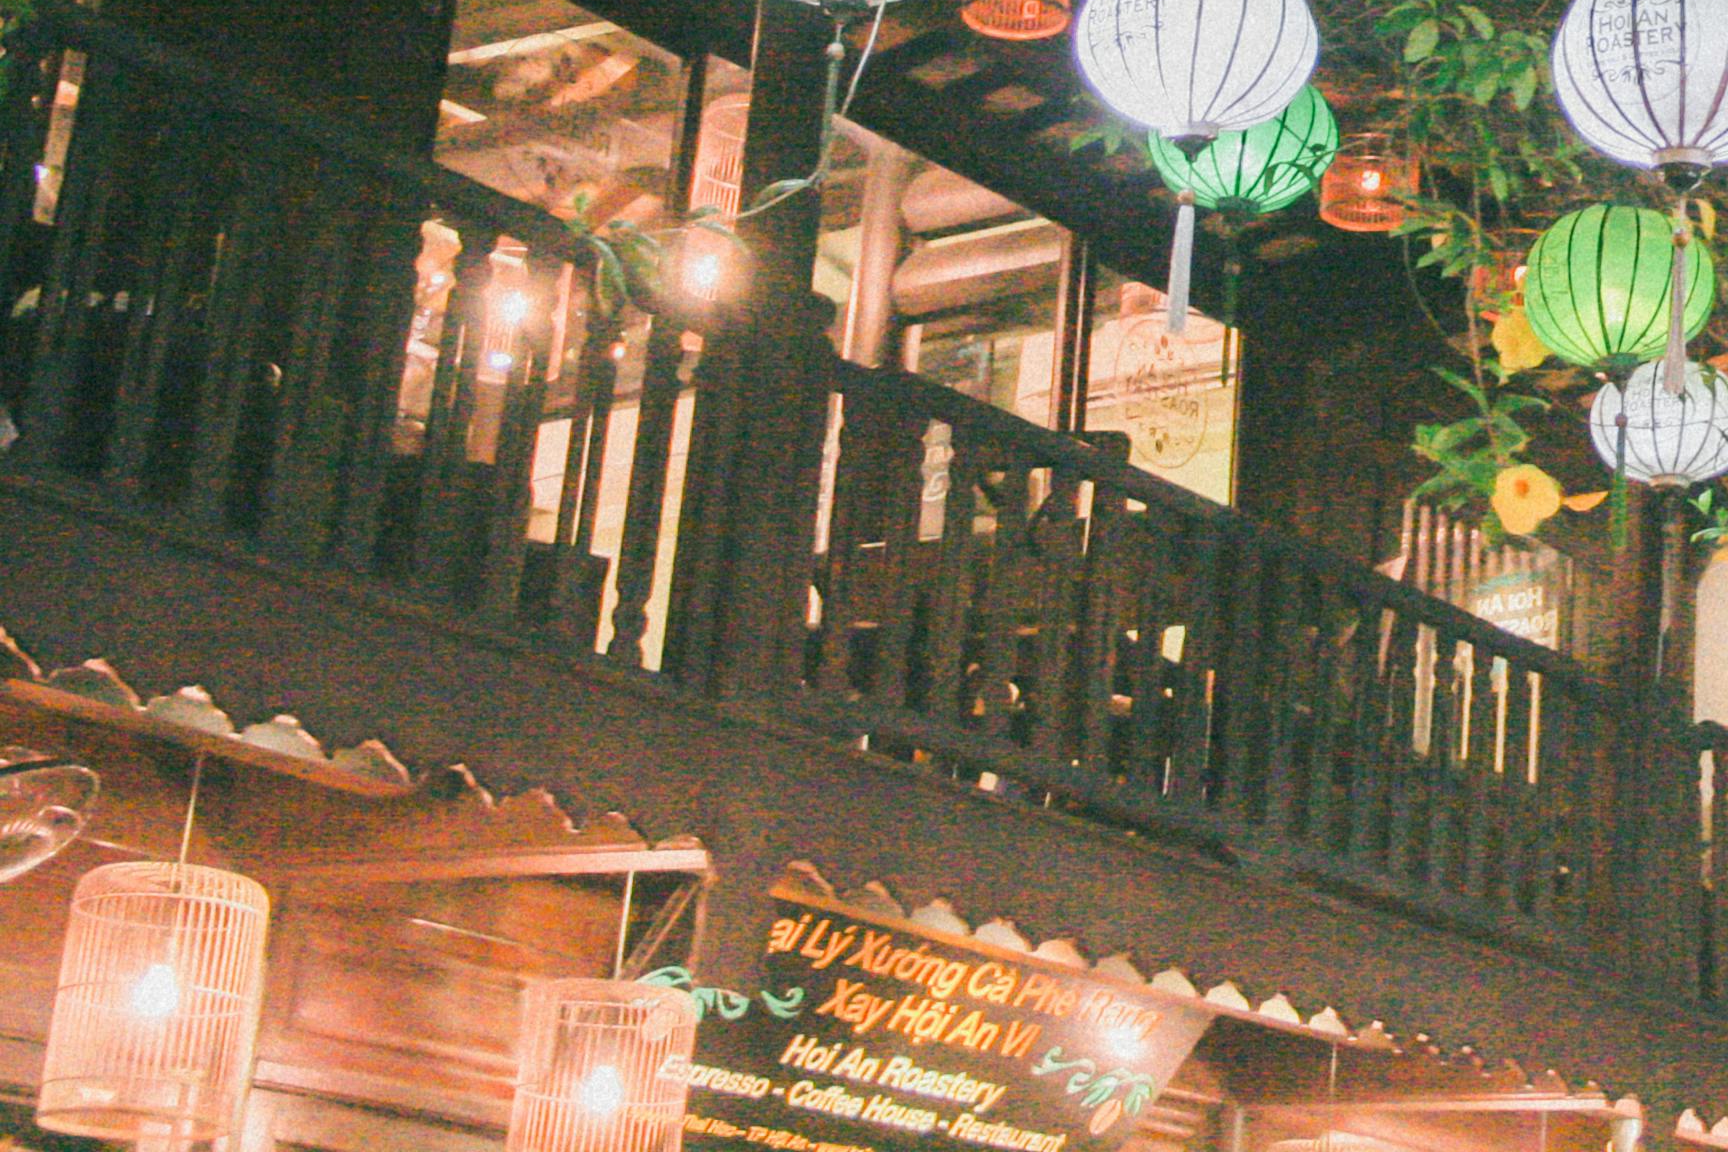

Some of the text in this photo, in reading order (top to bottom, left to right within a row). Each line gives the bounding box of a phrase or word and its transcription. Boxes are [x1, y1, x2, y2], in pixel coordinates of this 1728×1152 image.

[1635, 8, 1668, 27] AN
[800, 919, 858, 969] Lý
[816, 978, 895, 1035] Xay
[944, 1009, 1001, 1051] An
[779, 1034, 1008, 1113] Hoi An Roastery
[787, 1080, 865, 1120] Coffee
[860, 1094, 938, 1133] House
[948, 1112, 1068, 1152] Restaurant
